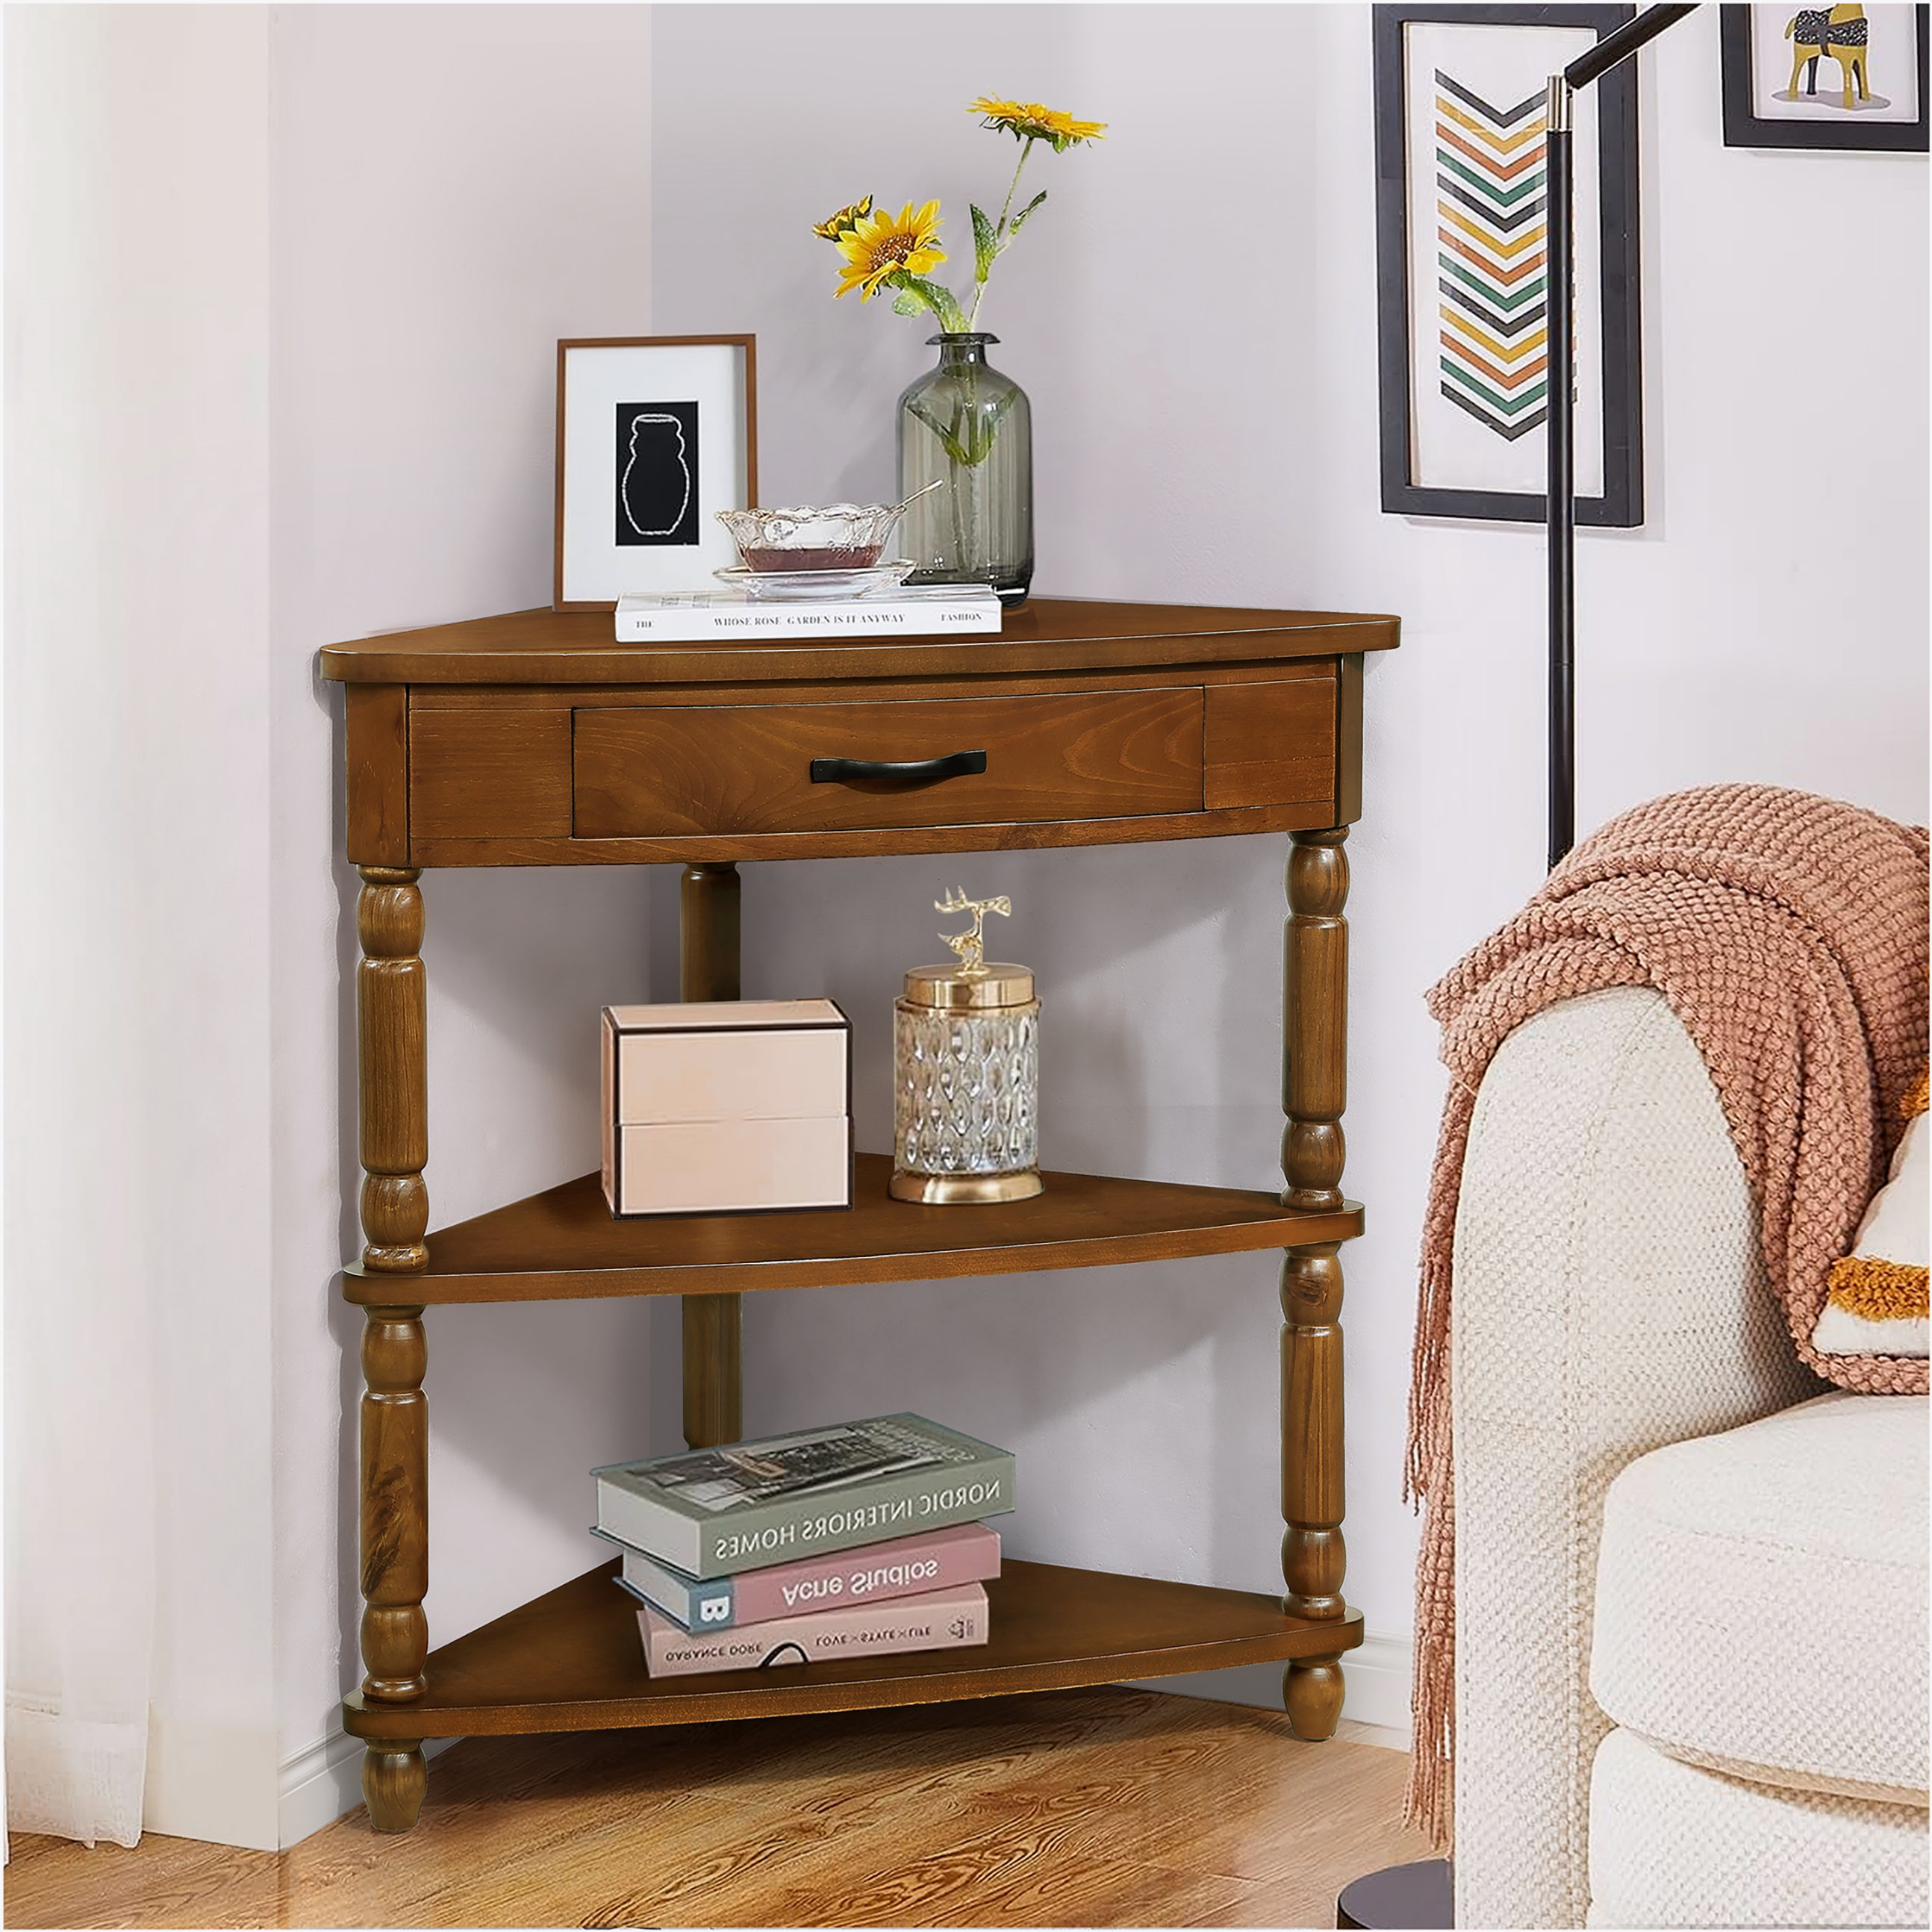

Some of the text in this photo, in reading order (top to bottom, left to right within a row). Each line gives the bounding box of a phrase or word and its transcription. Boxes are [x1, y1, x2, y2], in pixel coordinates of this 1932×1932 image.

[714, 617, 752, 626] WHOSE
[755, 617, 782, 626] ROSE
[787, 616, 832, 624] GARDEN
[834, 615, 844, 623] IS
[861, 614, 906, 623] ANYWAY
[941, 613, 982, 621] FASHION
